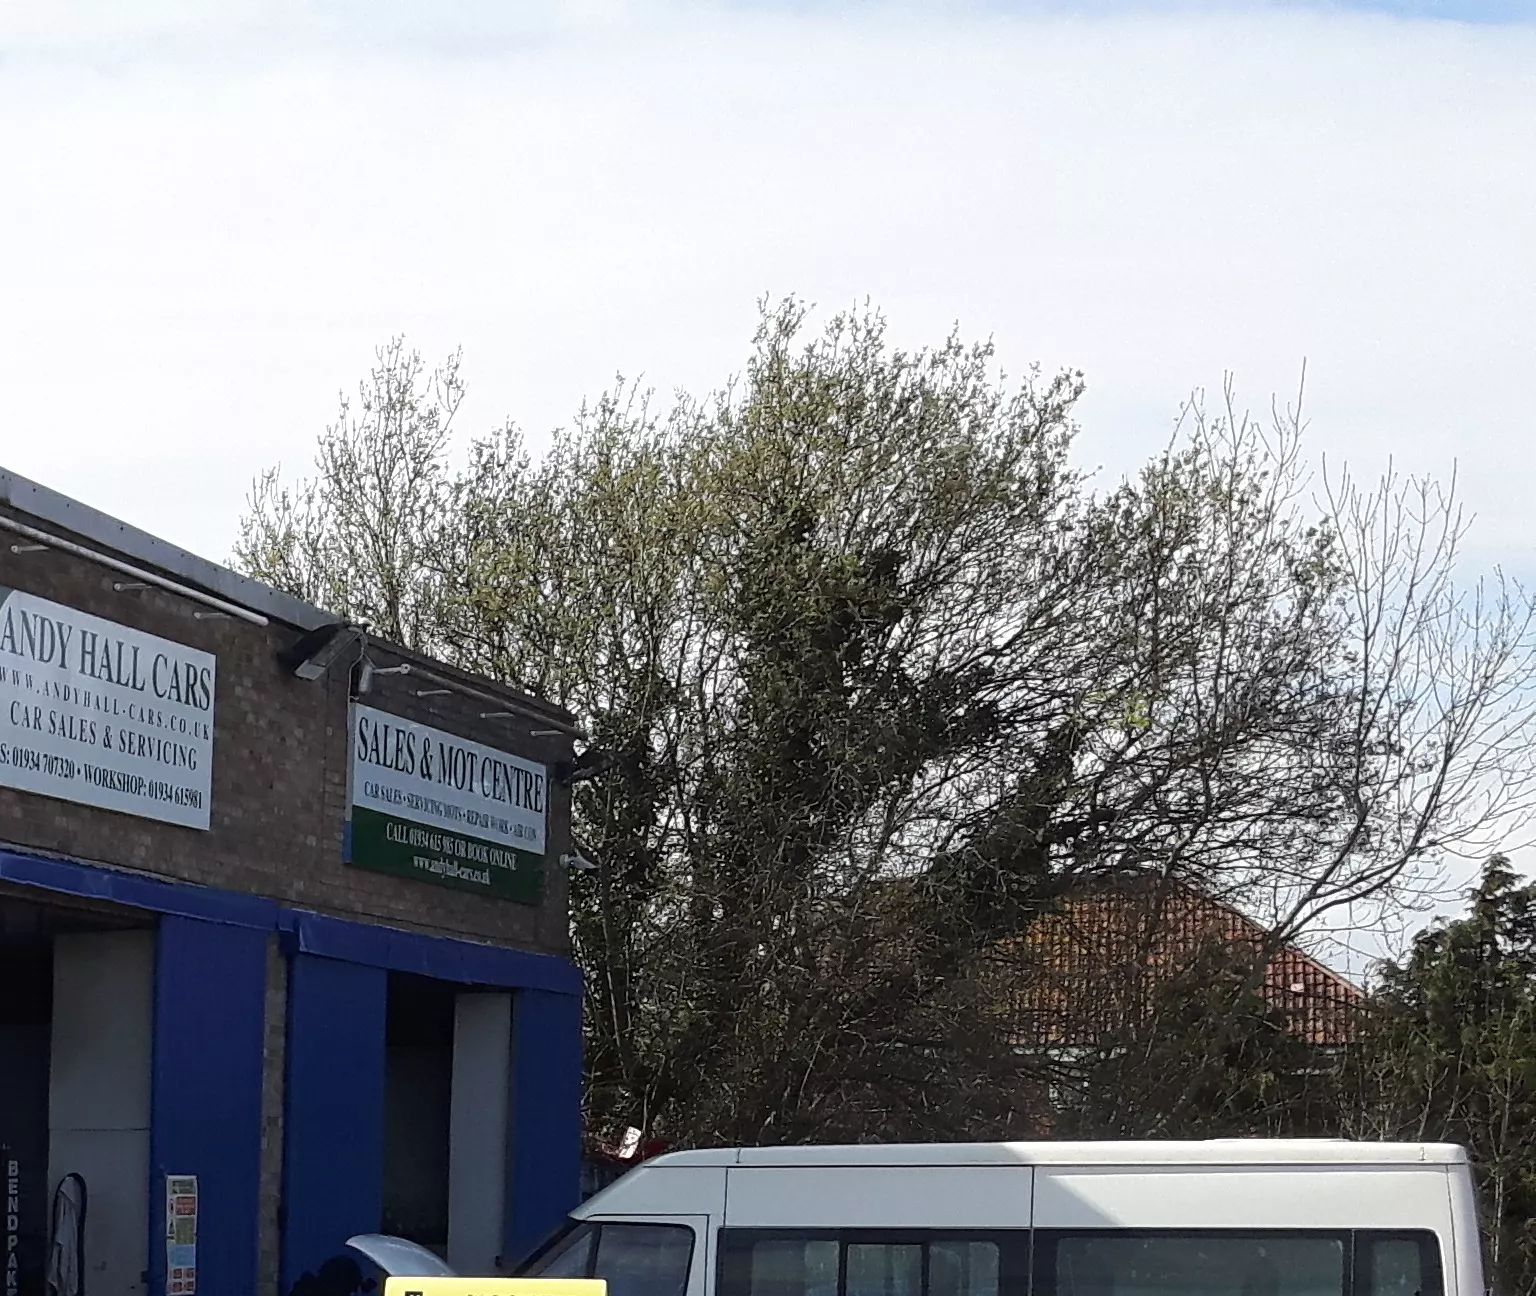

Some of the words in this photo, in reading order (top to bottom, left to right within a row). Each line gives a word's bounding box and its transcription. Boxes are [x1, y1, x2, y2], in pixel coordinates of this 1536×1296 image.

[0, 606, 73, 670] ANDY
[78, 628, 146, 692] HALL
[152, 653, 211, 712] CARS
[10, 700, 42, 731] CAR
[48, 710, 97, 746] SALES
[103, 728, 113, 749] &
[119, 730, 197, 771] SERVICING
[358, 716, 416, 775] SALES
[420, 736, 434, 781] &
[438, 742, 478, 794] MOT
[481, 756, 544, 813] CENTRE
[12, 746, 41, 772] 01934
[43, 753, 75, 780] 707320
[83, 764, 147, 798] WORKSHOP:
[148, 780, 173, 804] 01934
[386, 822, 408, 844] CALL
